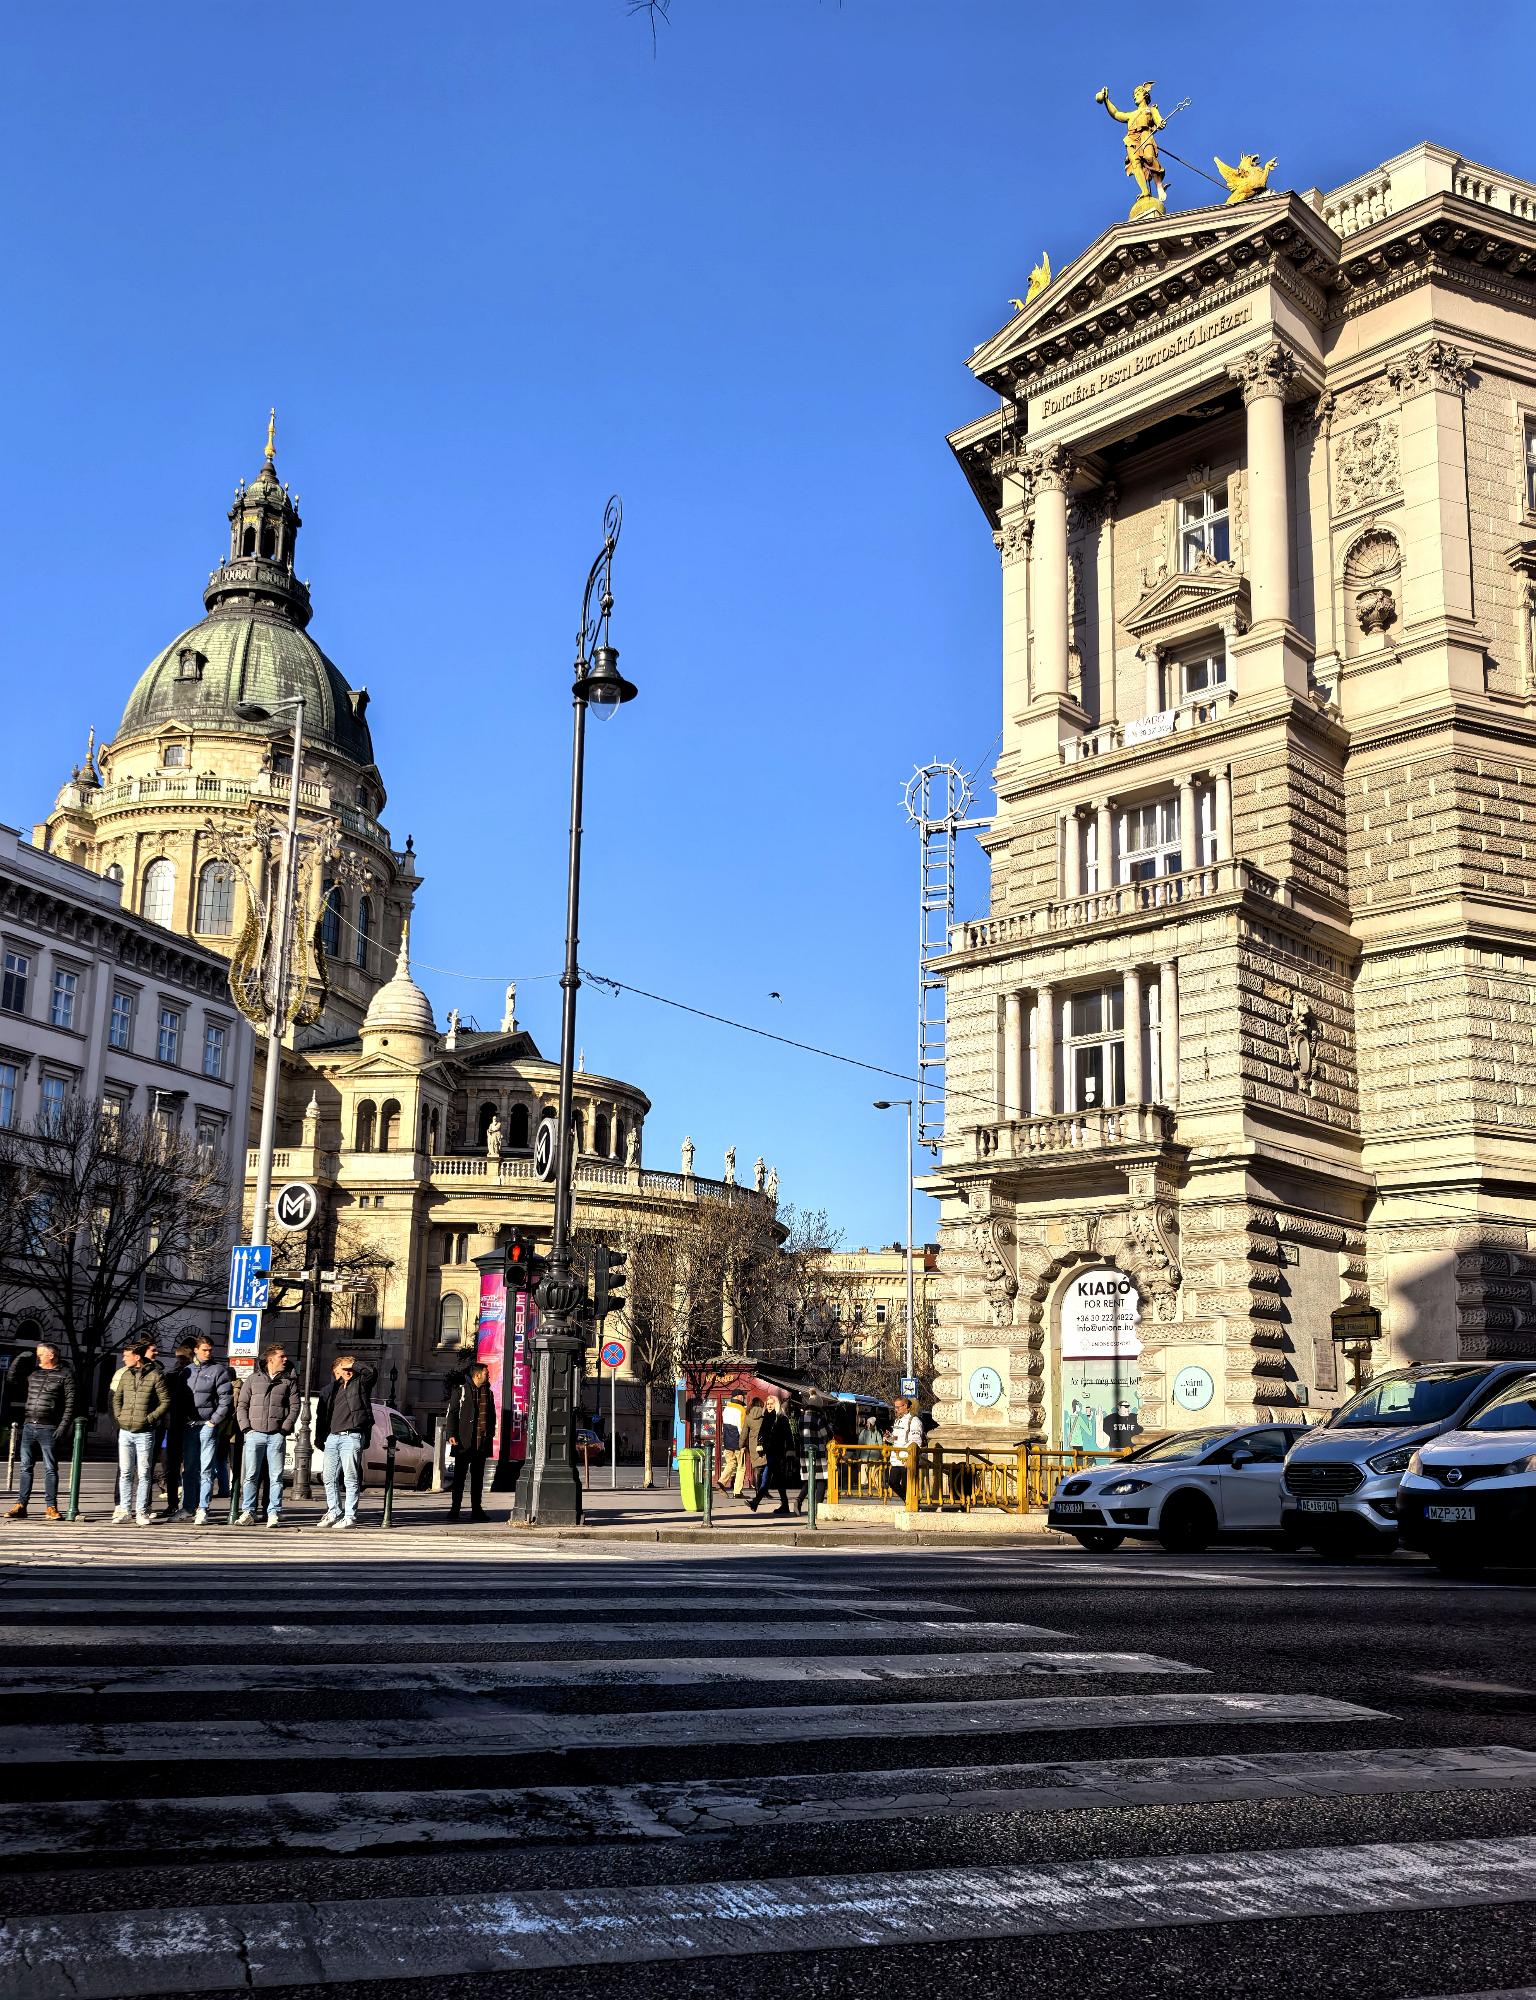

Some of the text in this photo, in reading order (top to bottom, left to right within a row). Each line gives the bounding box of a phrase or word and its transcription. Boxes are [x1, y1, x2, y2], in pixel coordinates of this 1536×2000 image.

[1098, 366, 1132, 393] PESTI
[1133, 329, 1197, 377] BIZTOSÍTÓ
[1197, 307, 1249, 346] INTÉZET
[282, 1193, 305, 1218] M
[1078, 1276, 1131, 1297] KIADÓ
[1084, 1298, 1125, 1309] FOR RENT
[237, 1318, 253, 1339] P
[512, 1294, 526, 1441] LIGHT ART MUSEUM
[1113, 1423, 1135, 1431] STAFF
[1430, 1507, 1473, 1520] MZP-321
